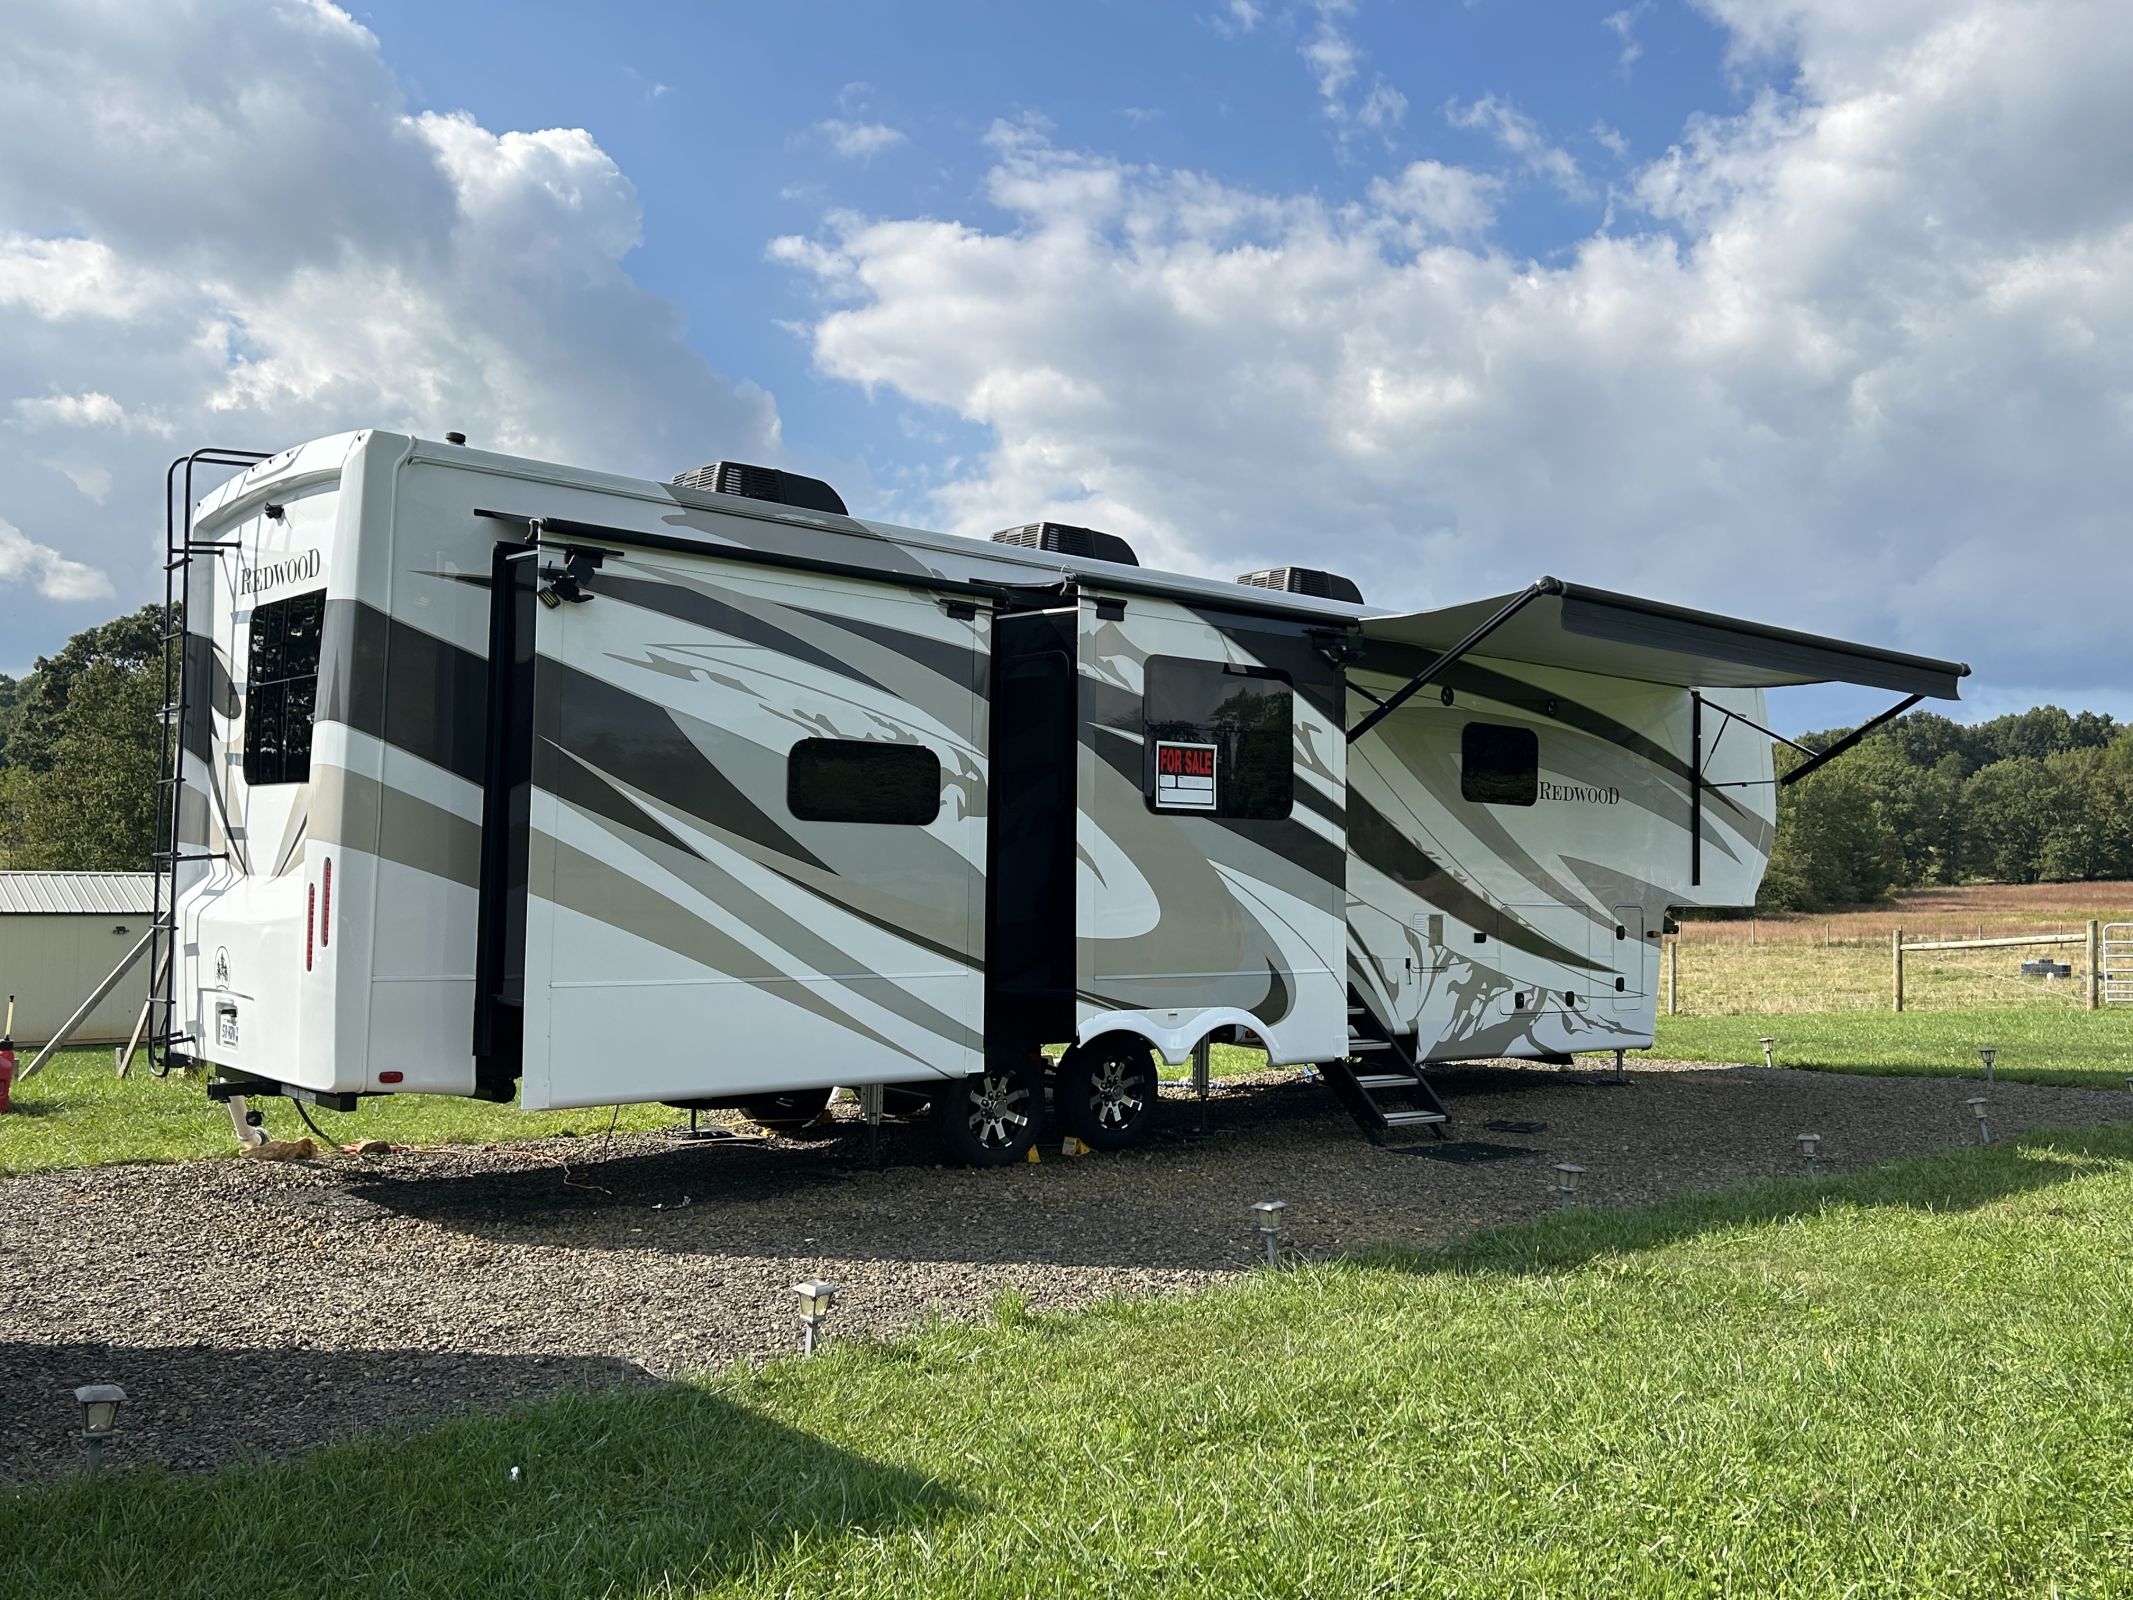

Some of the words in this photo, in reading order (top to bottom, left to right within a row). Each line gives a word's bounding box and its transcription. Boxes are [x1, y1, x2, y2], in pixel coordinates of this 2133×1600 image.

[240, 549, 320, 595] REDWOOD
[1161, 748, 1182, 773] FOR
[1185, 750, 1212, 775] SALE
[1539, 781, 1620, 805] REDWOOD
